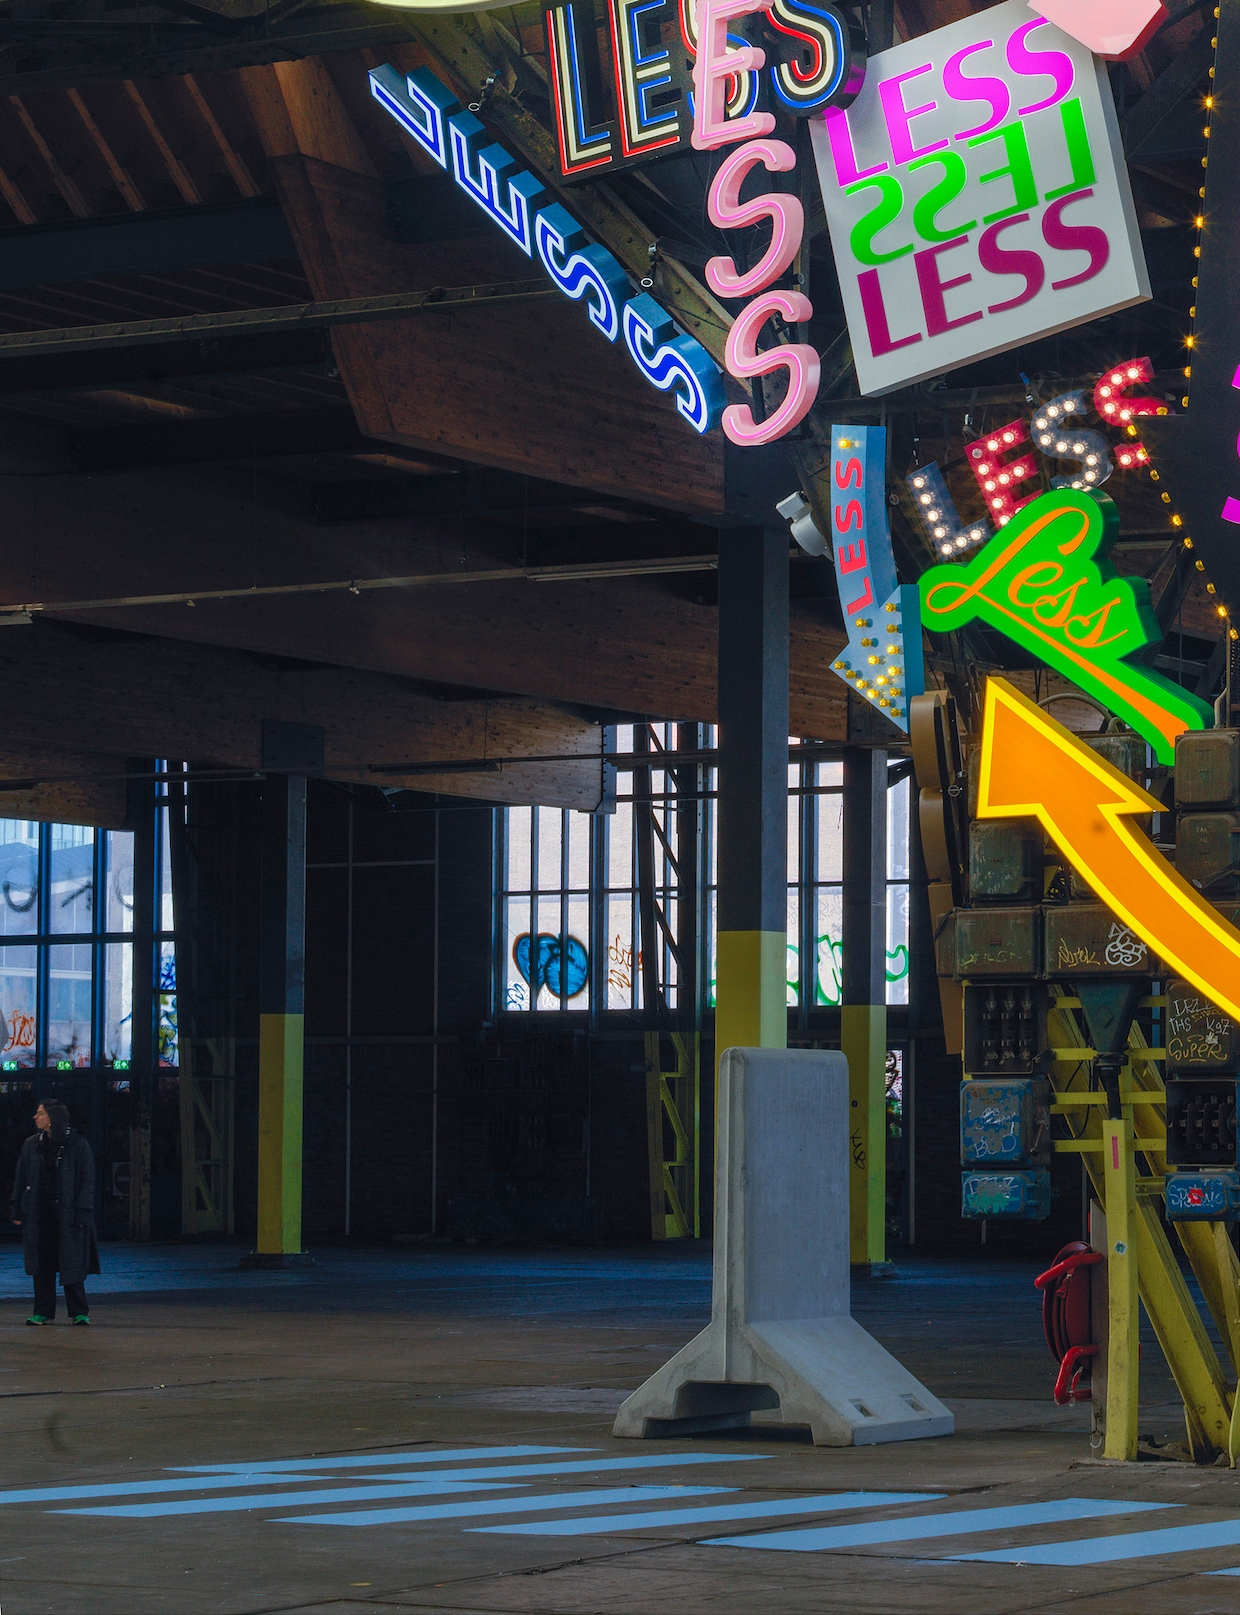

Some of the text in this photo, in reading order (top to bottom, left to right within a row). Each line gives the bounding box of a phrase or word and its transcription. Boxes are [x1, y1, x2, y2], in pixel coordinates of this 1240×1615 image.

[826, 15, 1075, 187] LESS
[368, 64, 715, 435] LESS
[856, 187, 1111, 358] LESS
[835, 456, 875, 617] LESS
[926, 506, 1190, 748] Less
